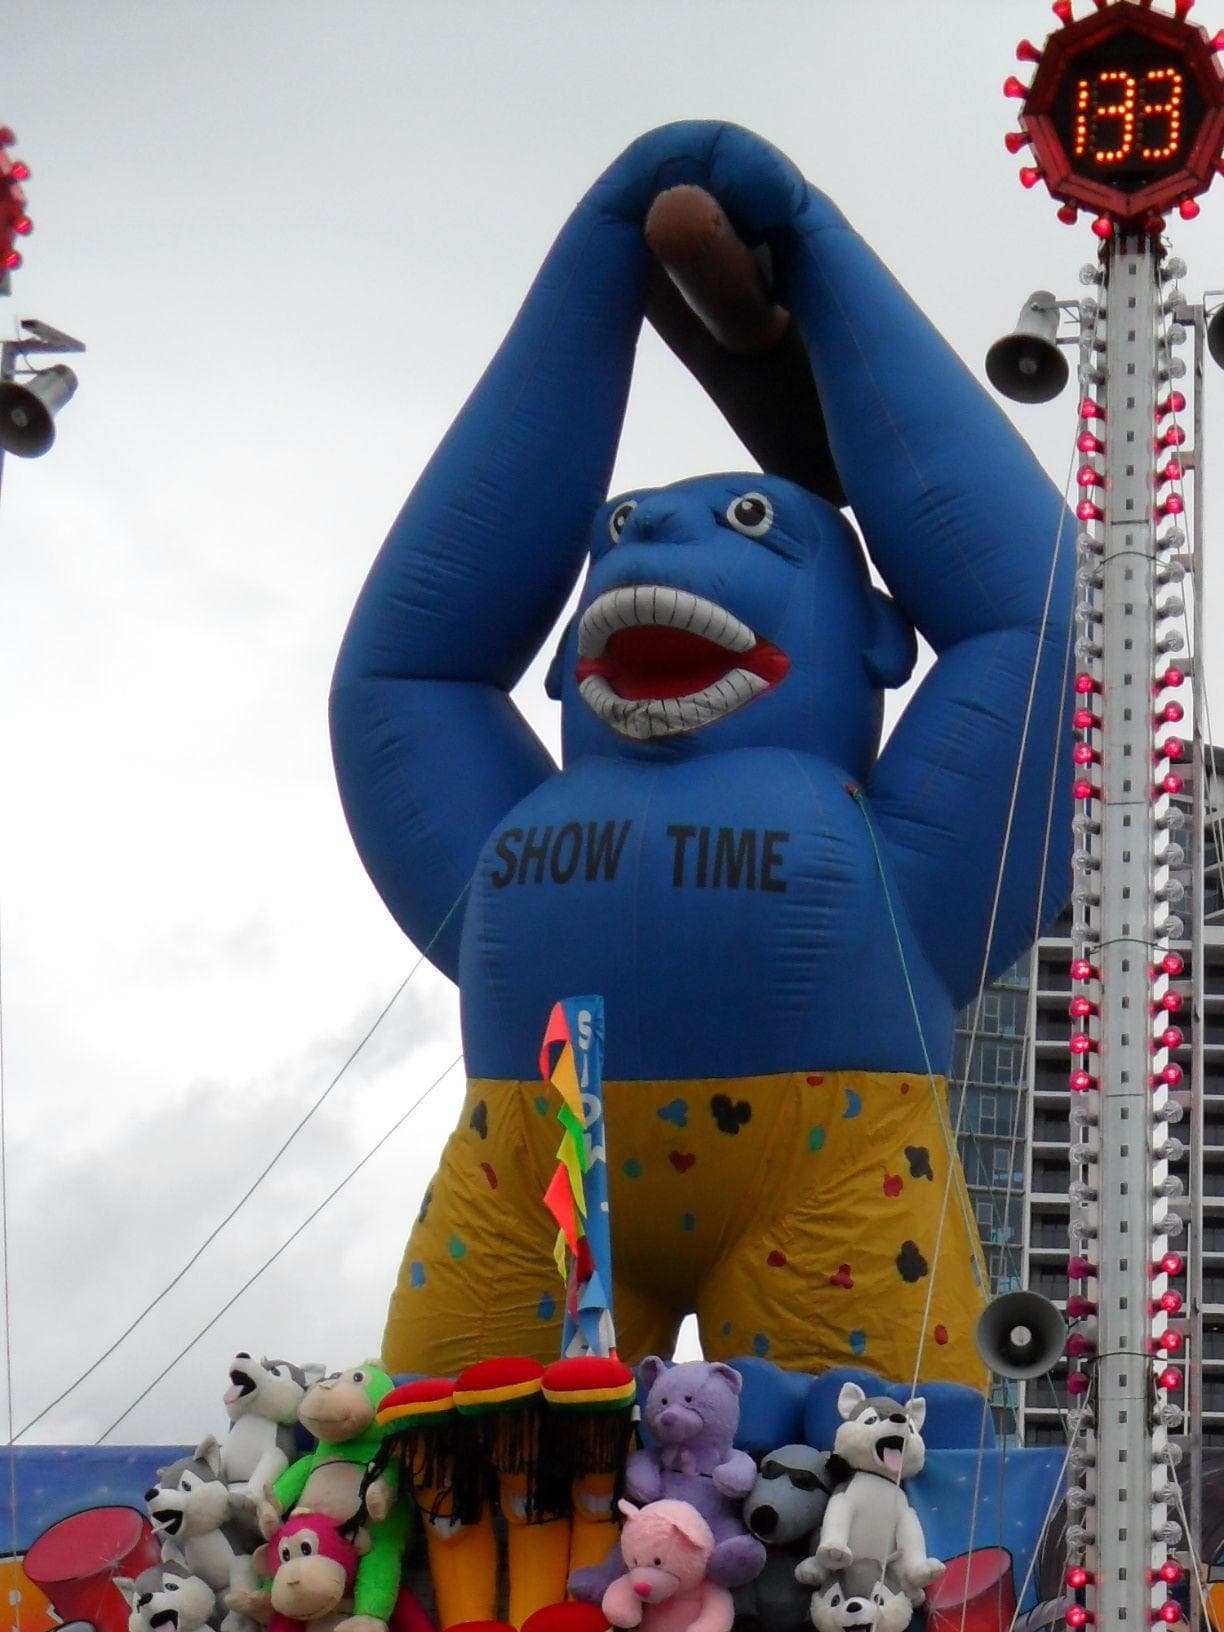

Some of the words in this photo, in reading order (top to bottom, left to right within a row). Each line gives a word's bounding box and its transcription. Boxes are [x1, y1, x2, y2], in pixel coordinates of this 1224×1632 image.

[1076, 67, 1183, 162] 133
[491, 818, 632, 890] SHOW
[666, 823, 790, 894] TIME
